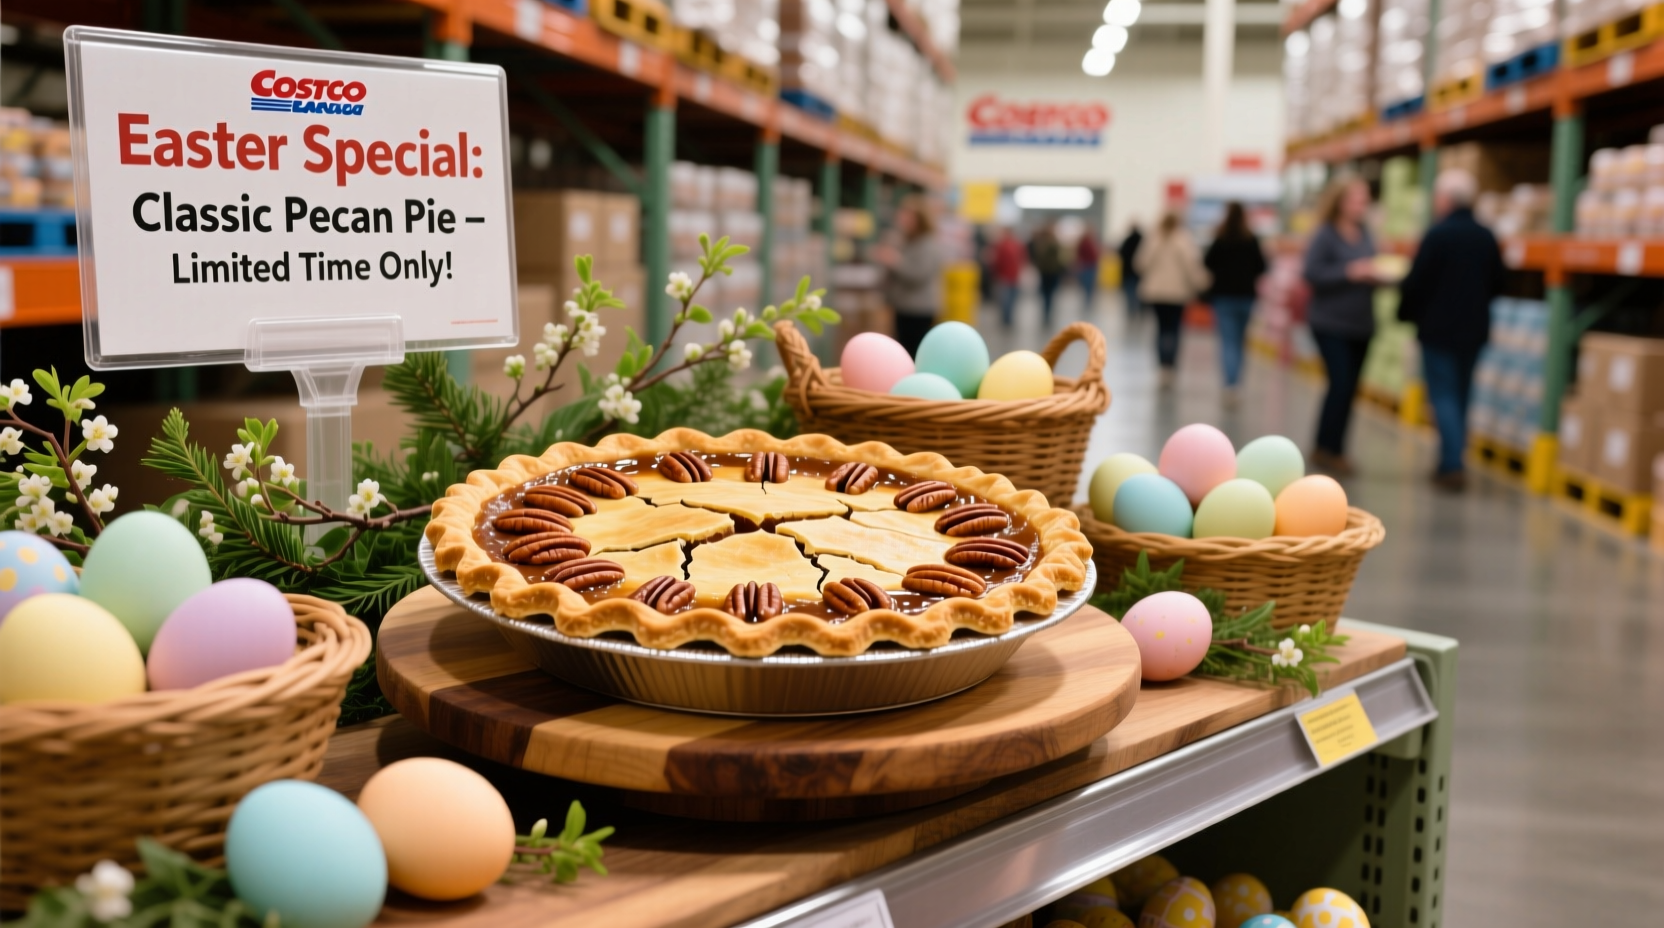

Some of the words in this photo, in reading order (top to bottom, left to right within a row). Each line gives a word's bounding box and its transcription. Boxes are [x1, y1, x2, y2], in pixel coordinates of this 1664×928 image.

[118, 113, 288, 171] Easter
[303, 124, 483, 187] Special:
[132, 191, 272, 233] Classic
[284, 196, 393, 234] Pecan
[404, 198, 456, 234] Pie
[172, 251, 290, 284] Limited
[298, 251, 371, 281] Time
[379, 250, 453, 288] Only!
